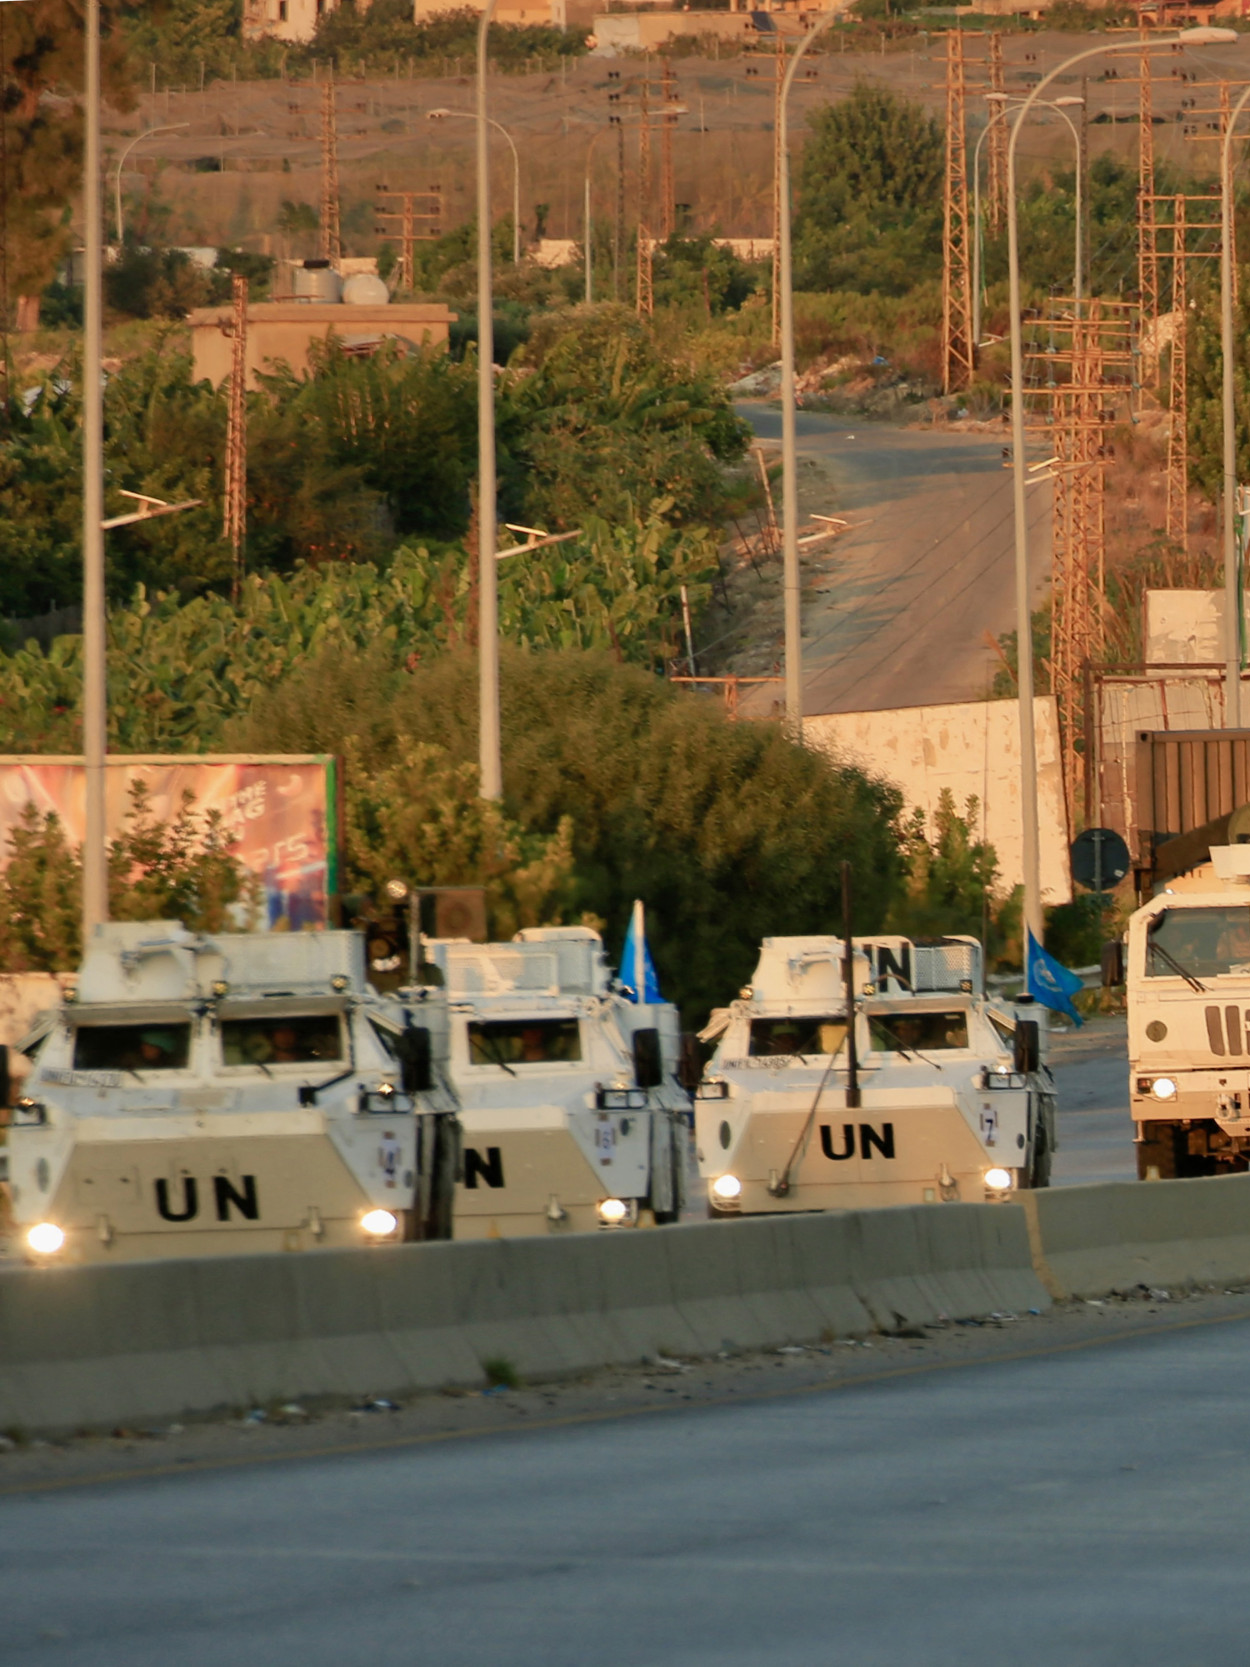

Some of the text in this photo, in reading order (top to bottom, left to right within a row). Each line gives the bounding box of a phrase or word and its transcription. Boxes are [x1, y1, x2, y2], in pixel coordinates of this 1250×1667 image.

[863, 942, 911, 993] N
[820, 1123, 896, 1160] UN
[155, 1175, 260, 1222] UN
